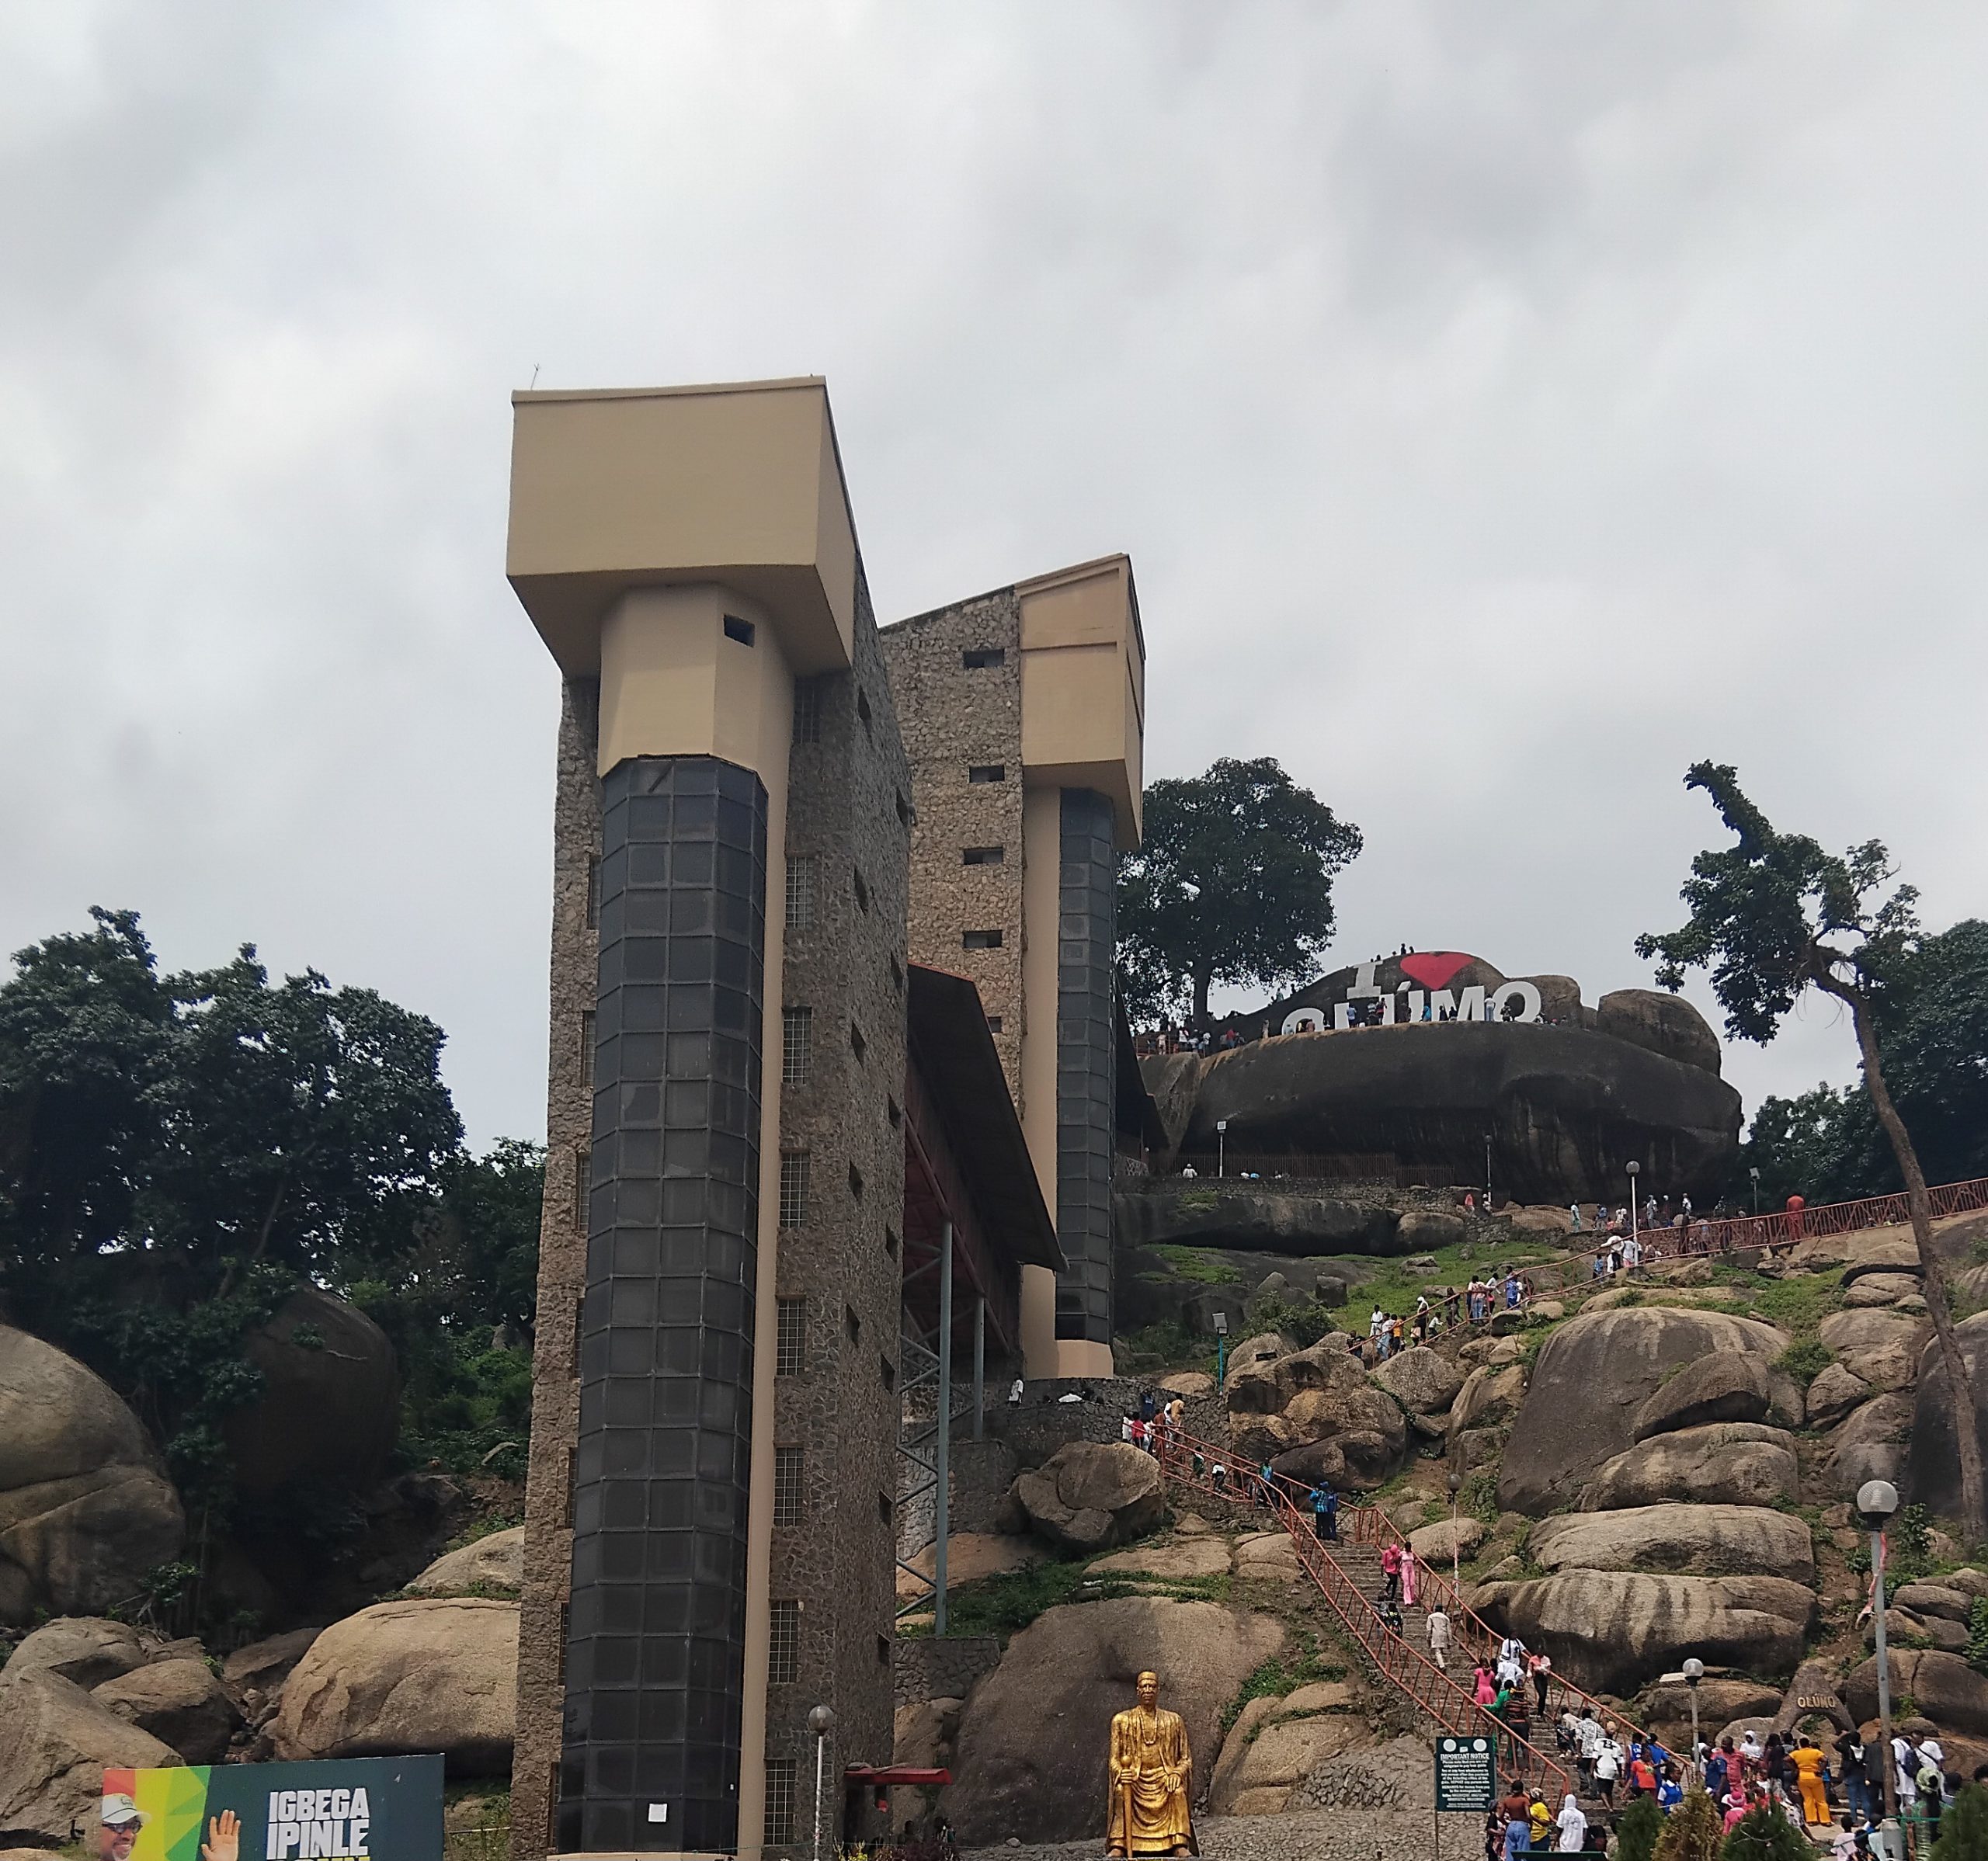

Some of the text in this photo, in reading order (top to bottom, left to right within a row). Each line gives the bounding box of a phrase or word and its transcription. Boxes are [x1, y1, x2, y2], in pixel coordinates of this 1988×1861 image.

[1347, 960, 1383, 1000] I
[269, 1787, 370, 1822] IGBEGA
[266, 1819, 369, 1859] IPINLE
